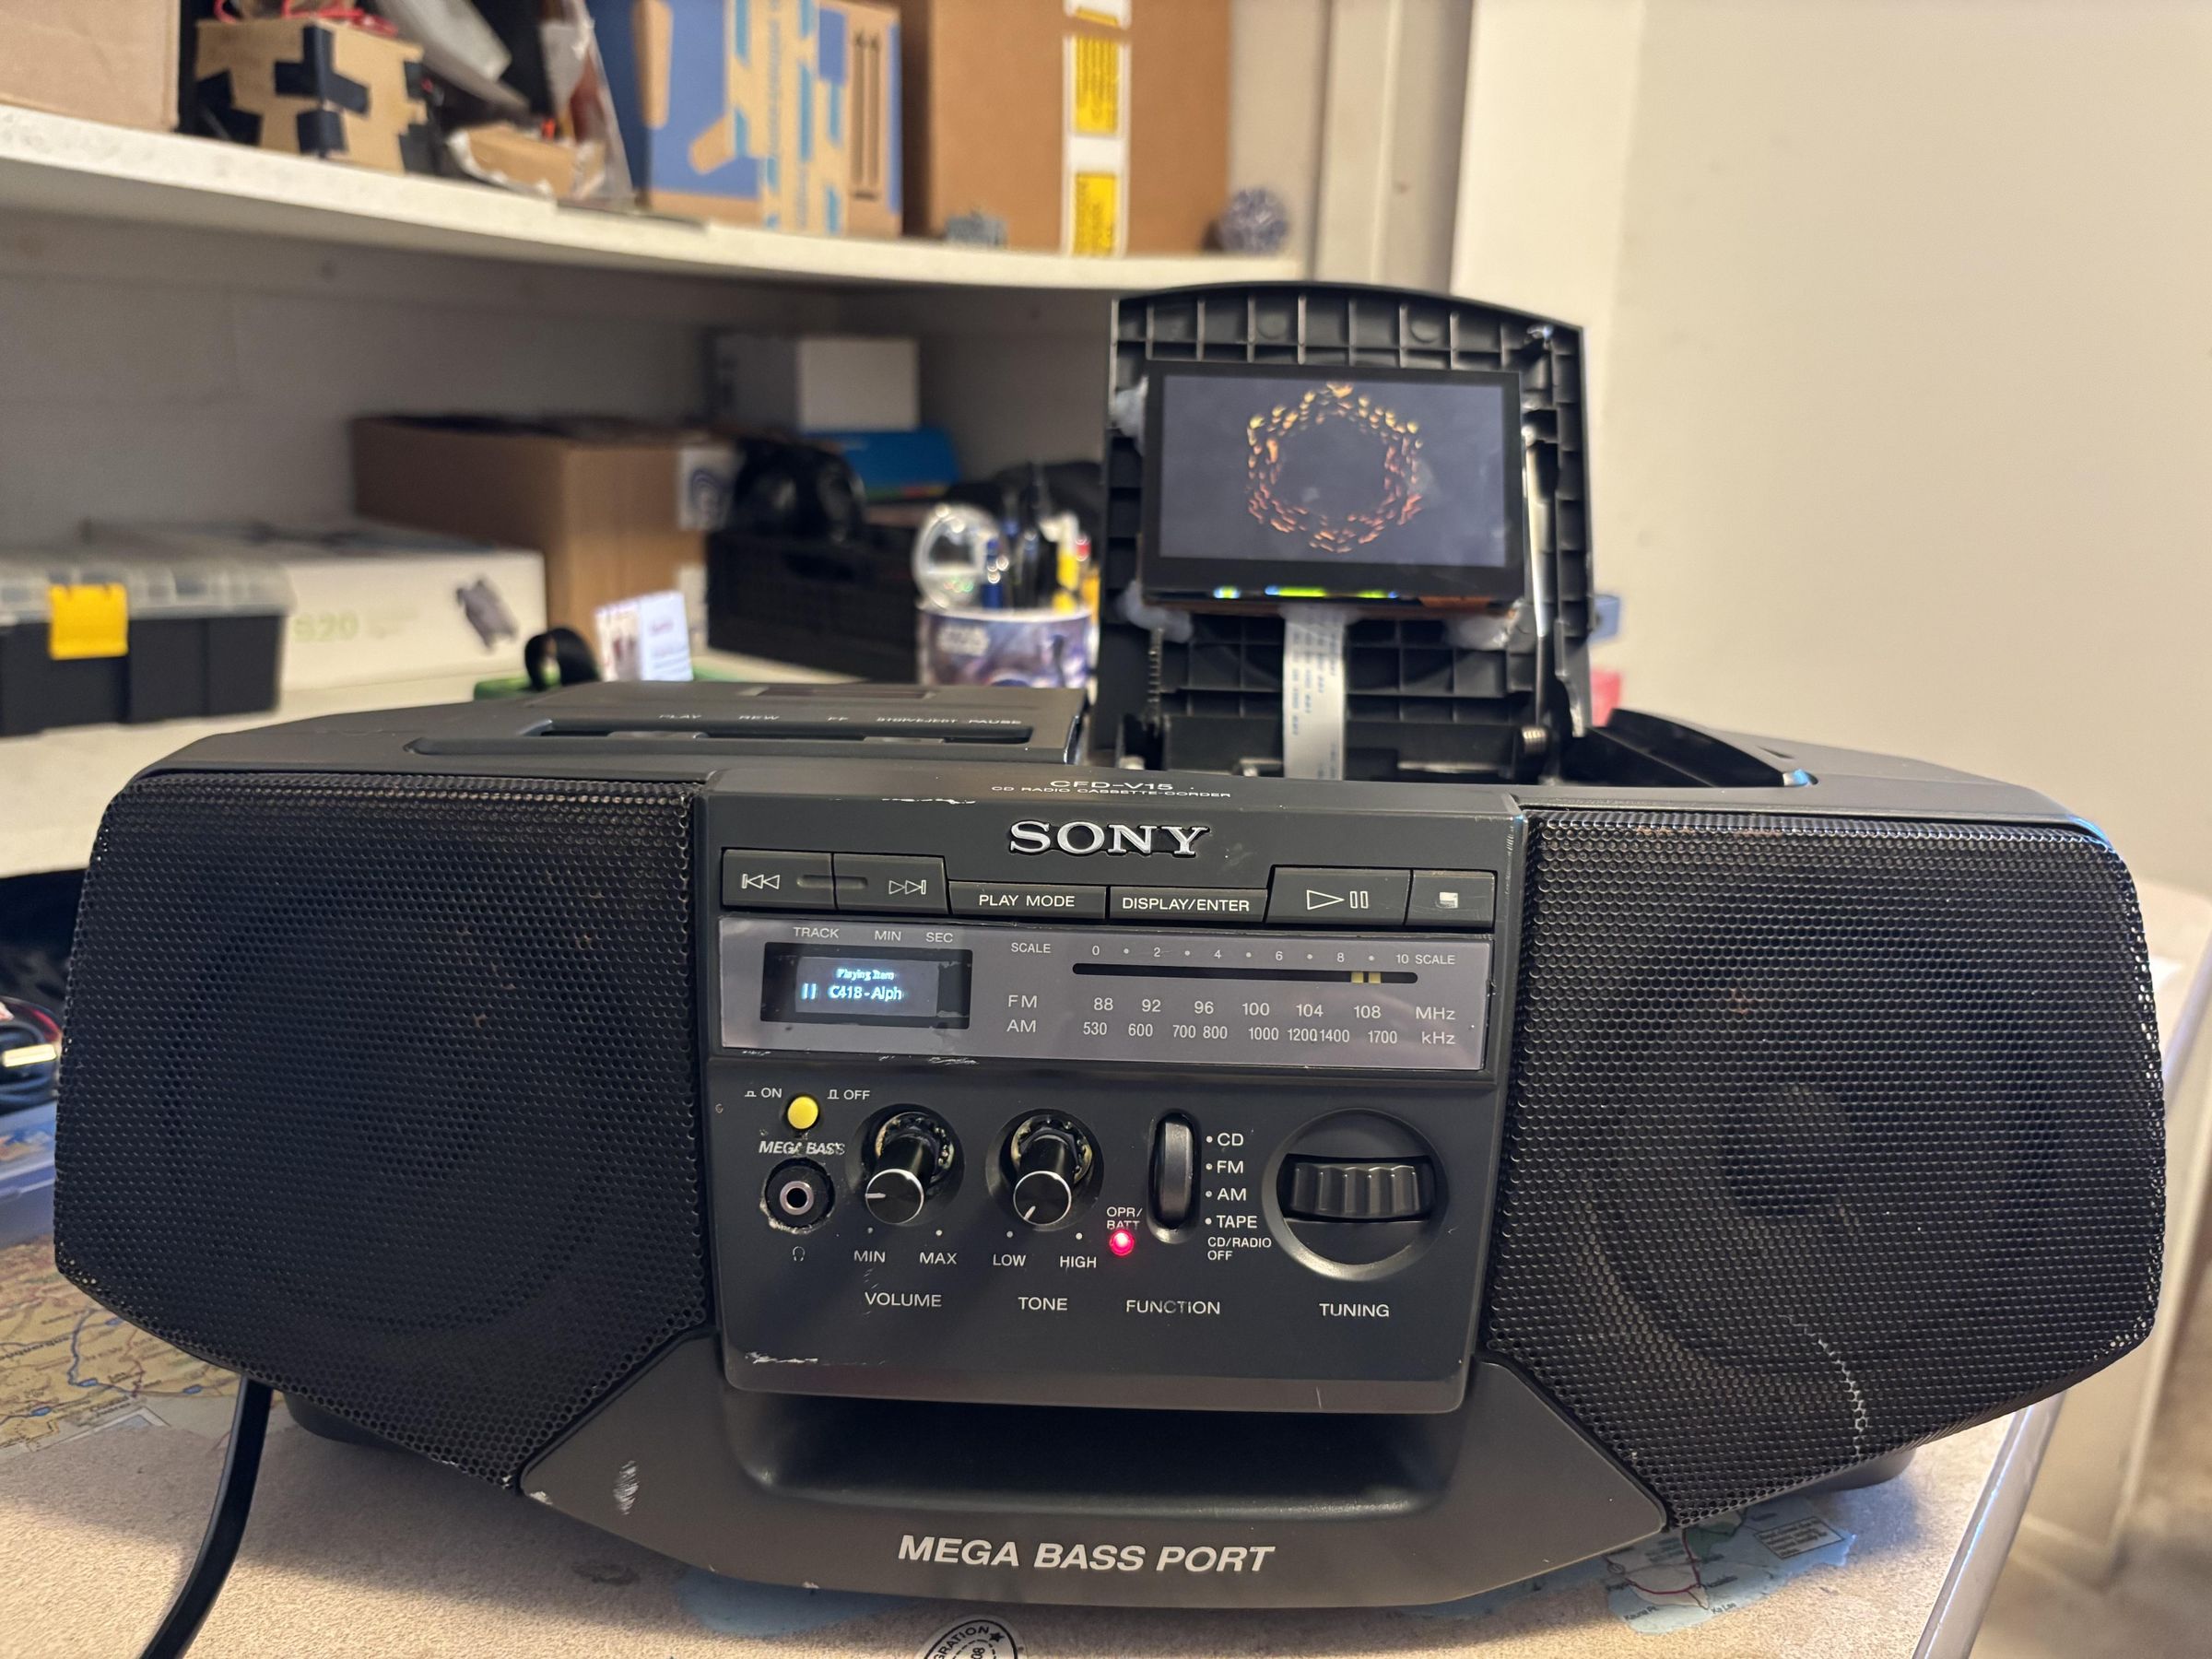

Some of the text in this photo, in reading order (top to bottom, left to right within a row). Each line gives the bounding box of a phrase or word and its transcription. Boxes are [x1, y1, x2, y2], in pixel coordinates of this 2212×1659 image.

[1050, 780, 1173, 791] CFD-V15
[1010, 820, 1210, 854] SONY
[979, 894, 1076, 907] PLAY MODE
[1122, 897, 1250, 912] DISPLAY/ENTER
[793, 926, 954, 943] TRACK MIN SEC
[1010, 942, 1455, 965] SCALE 0 2 4 6 8 10 SCALE
[830, 985, 863, 999] C418
[1007, 994, 1455, 1020] FM 88 92 96 100 104 108 MHz
[1006, 1018, 1455, 1045] AM 530 600 700 800 1000 1200 1400 1700 kHz
[760, 1087, 782, 1099] ON
[843, 1089, 871, 1100] OFF
[1217, 1133, 1244, 1147] CD
[806, 1141, 845, 1156] BASS
[1217, 1159, 1244, 1174] FM
[1217, 1187, 1247, 1202] AM
[1106, 1206, 1143, 1218] OPR/
[1106, 1219, 1140, 1231] BATT
[1216, 1215, 1258, 1229] TAPE
[1207, 1236, 1272, 1249] CD/RADIO
[853, 1250, 886, 1264] MIN
[919, 1252, 958, 1265] MAX
[993, 1253, 1027, 1267] LOW
[1059, 1255, 1097, 1269] HIGH
[1207, 1250, 1233, 1261] OFF
[865, 1291, 942, 1307] VOLUME
[1018, 1296, 1068, 1312] TONE
[1125, 1300, 1220, 1315] FUNCTION
[1318, 1303, 1390, 1318] TUNING
[898, 1535, 1276, 1572] MEGA BASS PORT
